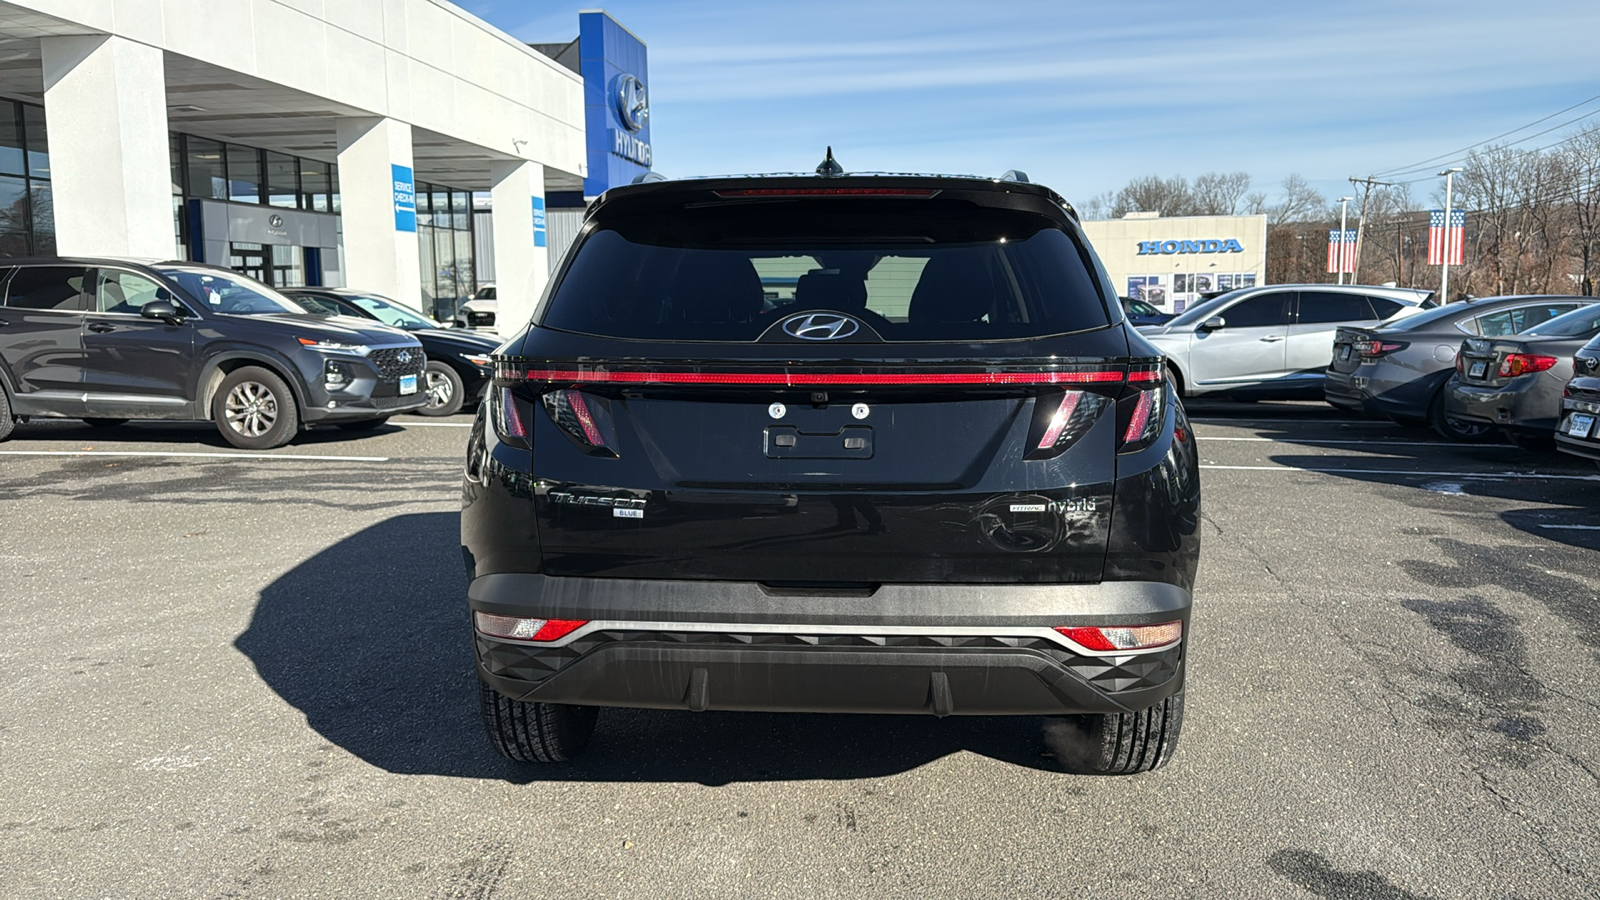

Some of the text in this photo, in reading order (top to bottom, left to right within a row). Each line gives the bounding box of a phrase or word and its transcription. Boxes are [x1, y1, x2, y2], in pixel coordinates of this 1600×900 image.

[1136, 239, 1244, 255] HONDA
[619, 508, 638, 517] BLUE
[1047, 498, 1096, 514] hybrid
